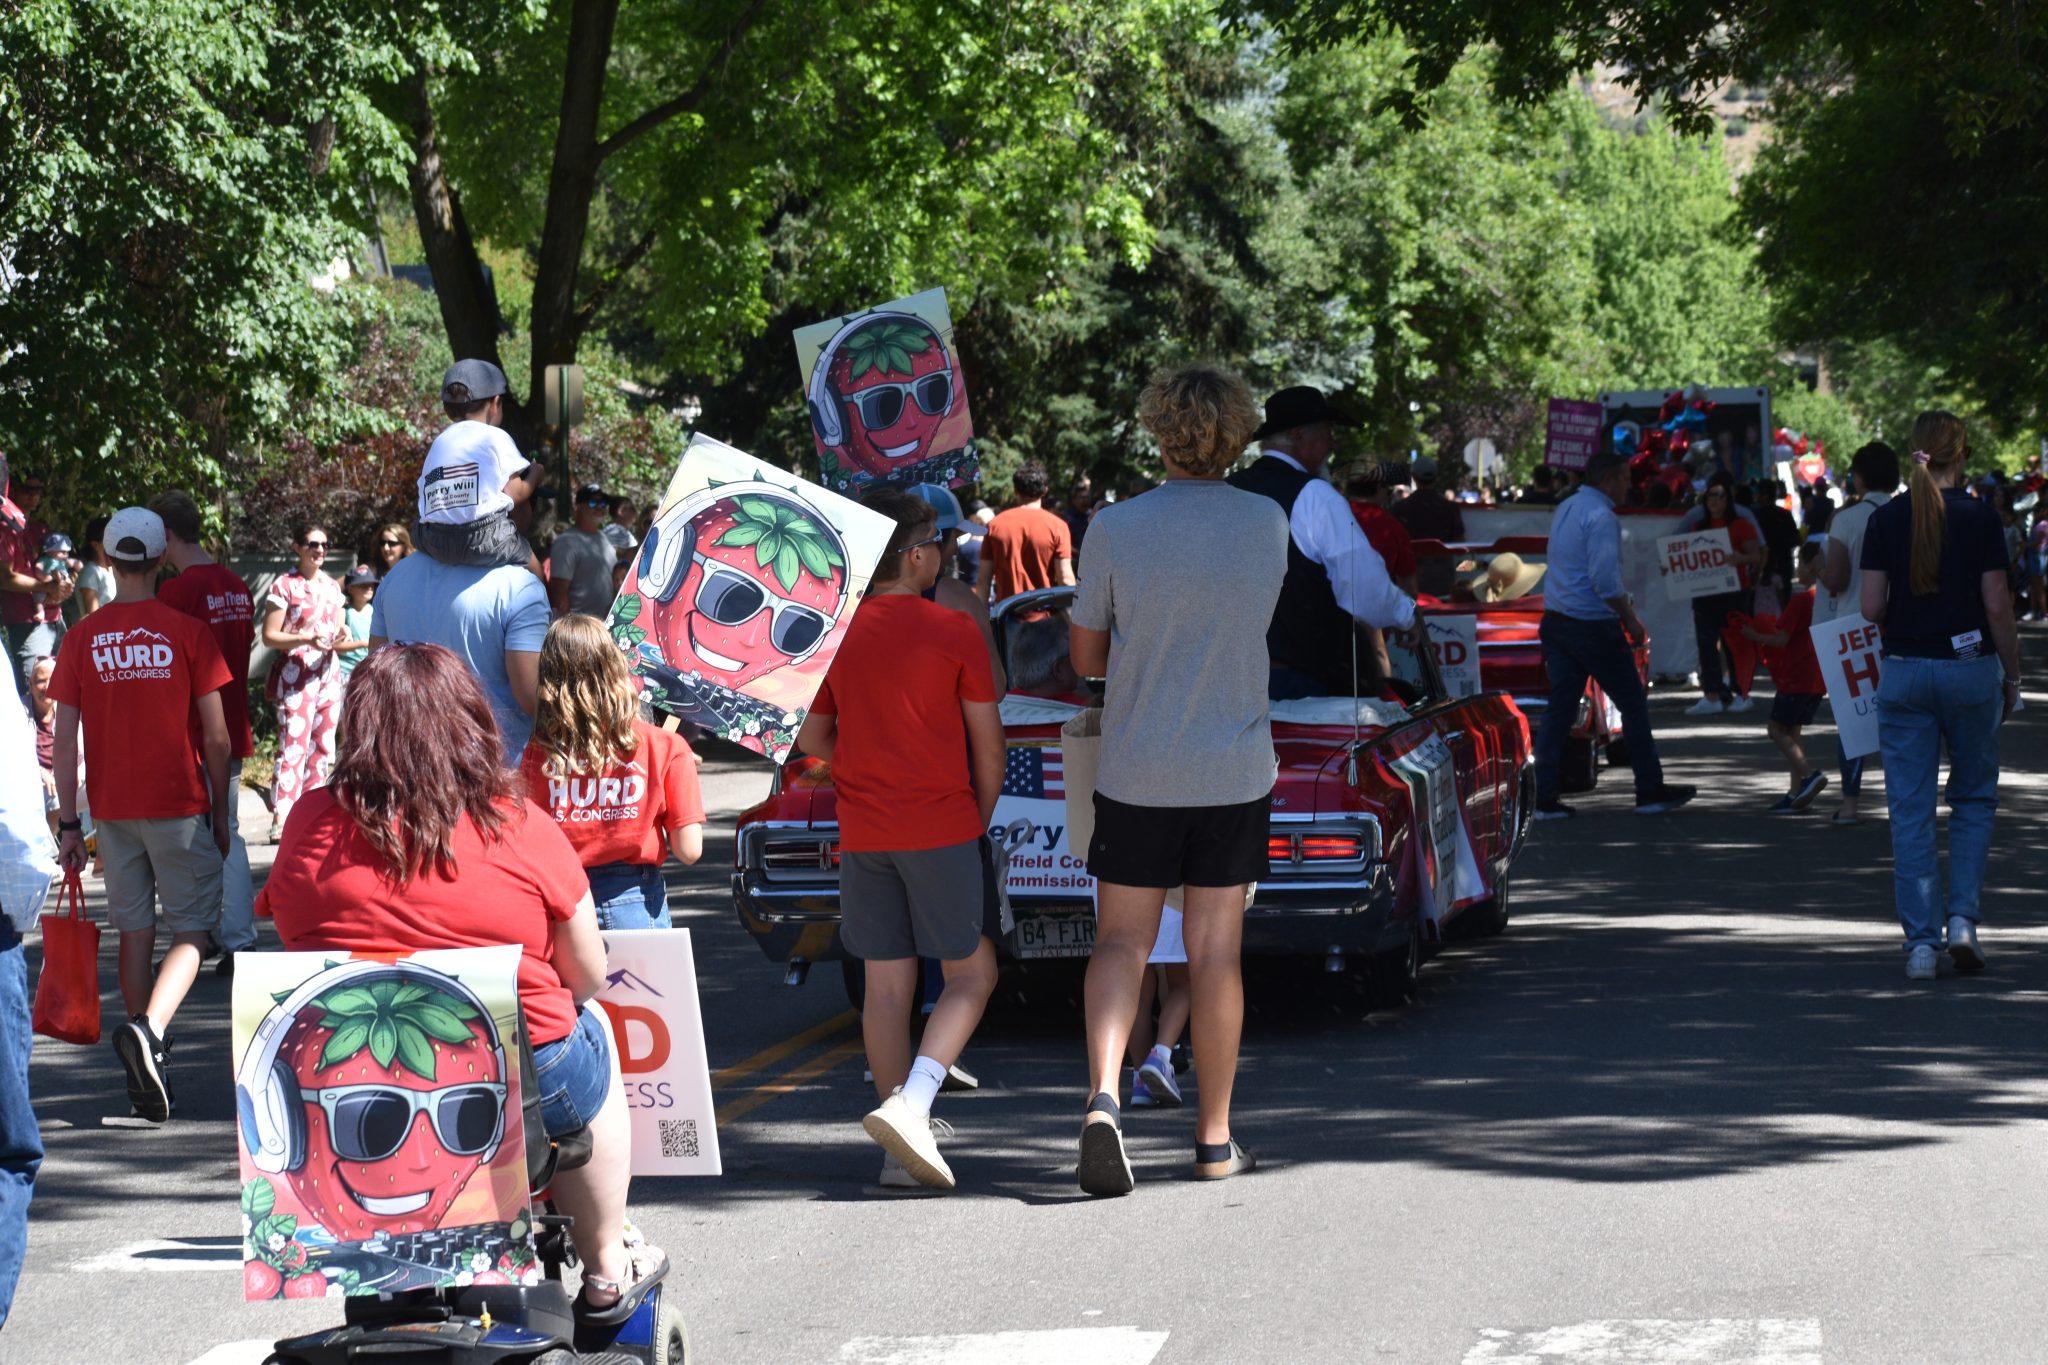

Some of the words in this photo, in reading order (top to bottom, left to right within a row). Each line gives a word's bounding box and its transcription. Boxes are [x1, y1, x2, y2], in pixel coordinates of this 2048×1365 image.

[1551, 439, 1584, 453] BECOME
[427, 486, 450, 500] Perry
[453, 481, 474, 491] Will
[1667, 540, 1689, 553] JEFF
[1668, 548, 1726, 573] HURD
[207, 594, 225, 609] Been
[91, 632, 124, 648] JEFF
[1838, 624, 1878, 655] JEF
[92, 644, 173, 672] HURD
[100, 671, 117, 683] U.S.
[117, 668, 171, 680] CONGRESS
[548, 775, 646, 808] HURD
[570, 807, 639, 822] CONGRESS
[988, 825, 1064, 851] erry
[1023, 921, 1047, 945] 64
[1058, 920, 1094, 943] FIR
